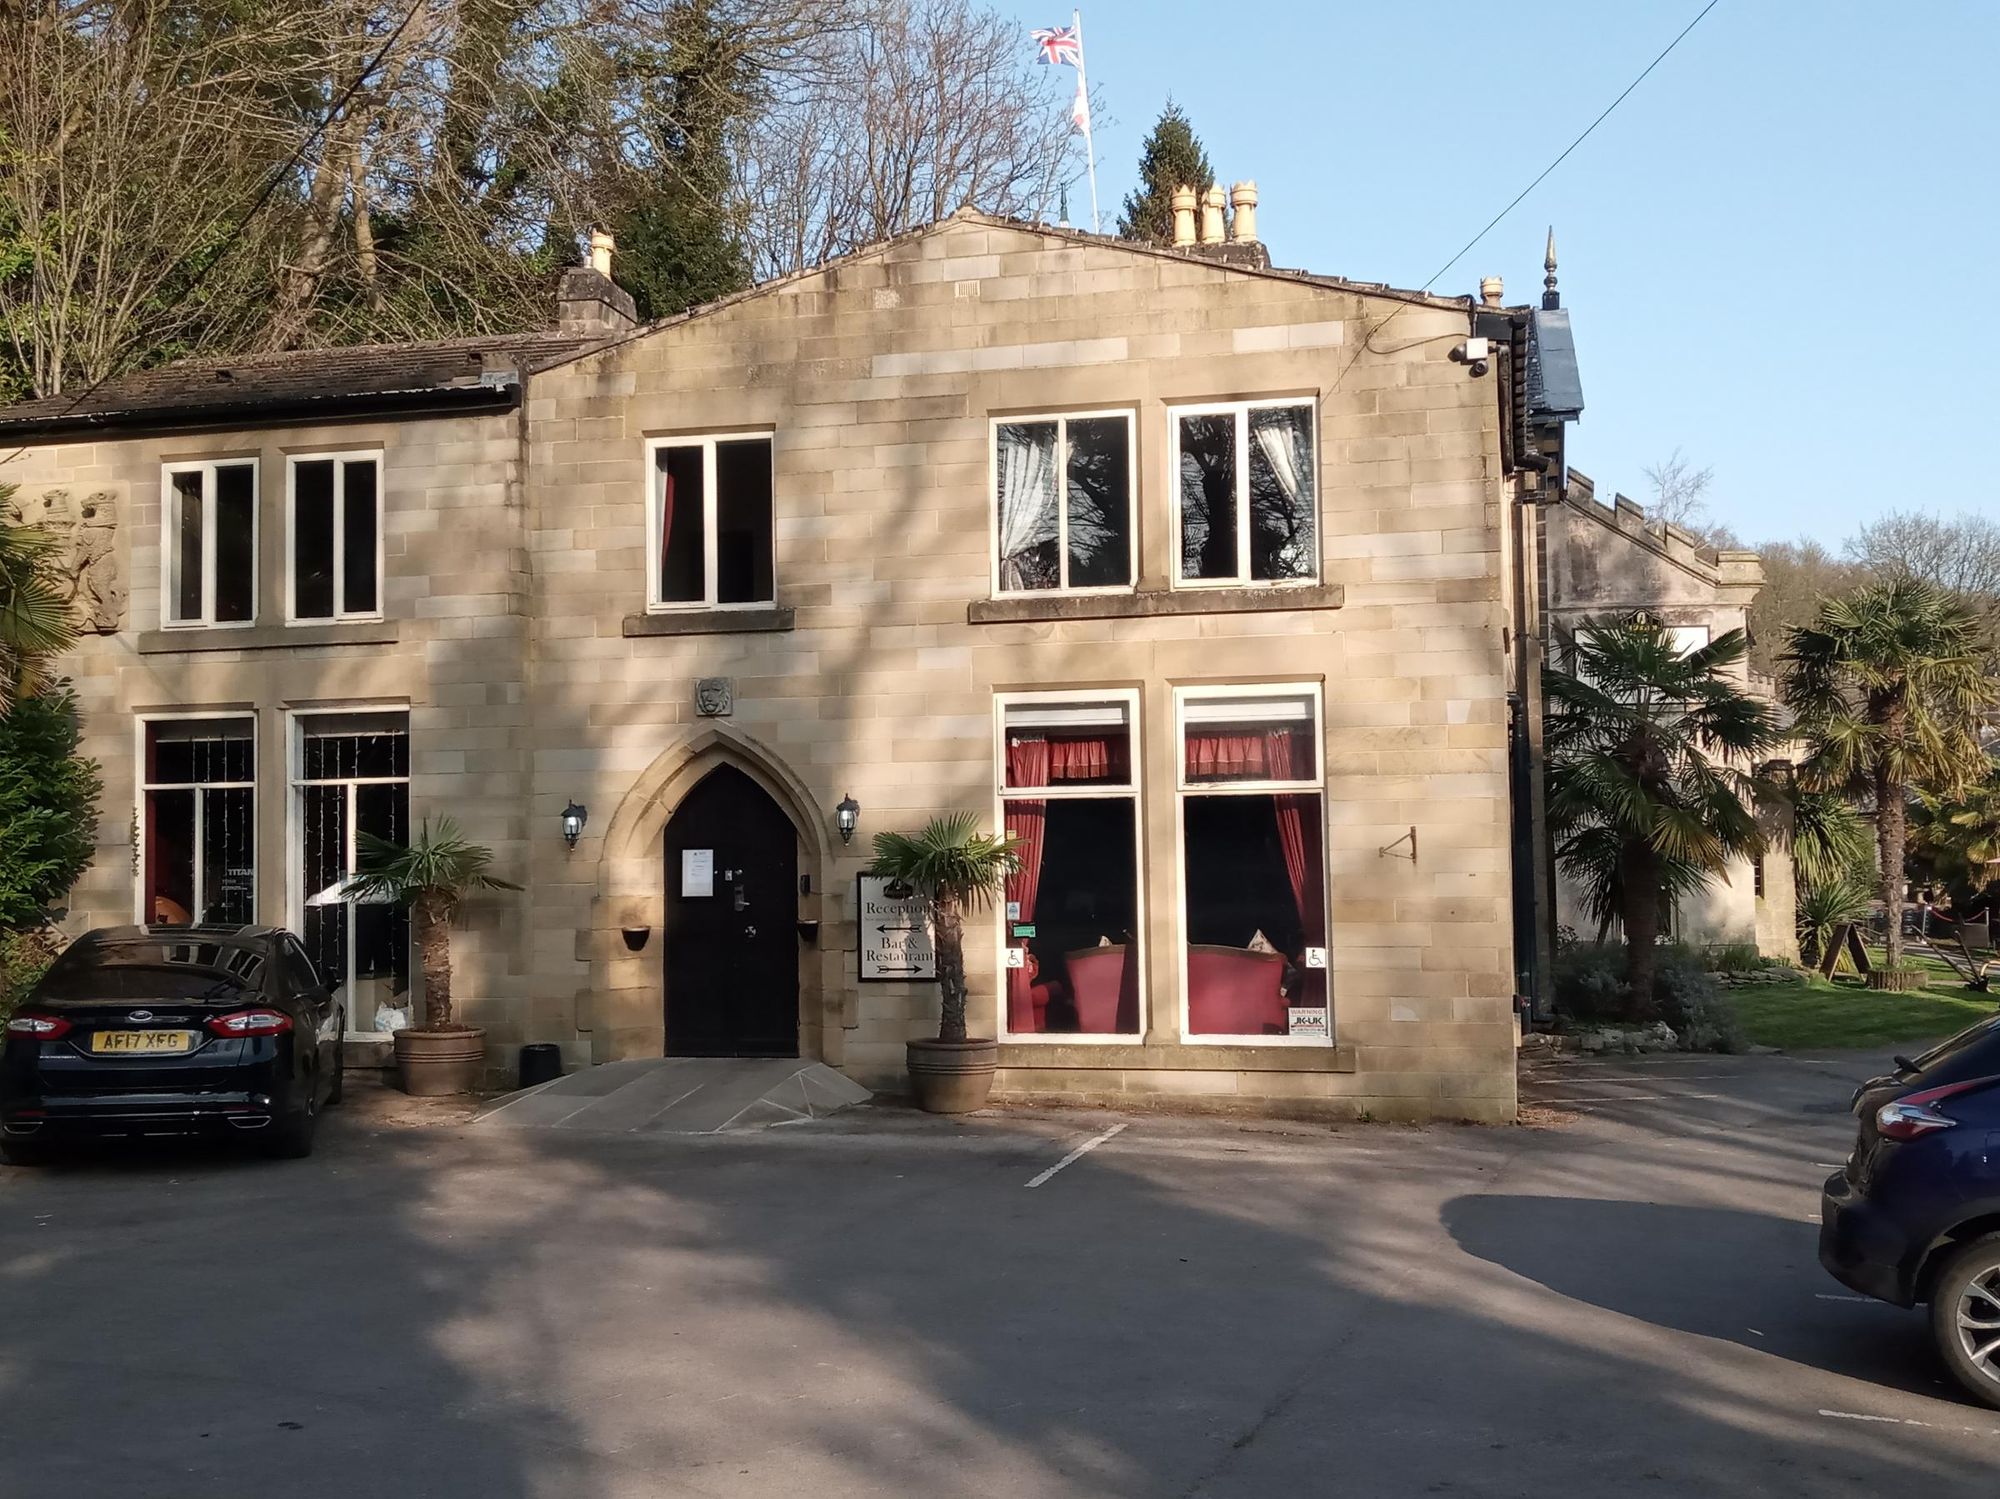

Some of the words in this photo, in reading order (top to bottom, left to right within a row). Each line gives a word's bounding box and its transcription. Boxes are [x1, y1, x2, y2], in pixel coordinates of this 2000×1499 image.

[866, 902, 930, 916] Reception
[881, 937, 903, 949] Bar
[908, 937, 919, 949] &
[866, 949, 933, 962] Restaurant
[104, 1033, 141, 1049] AF17
[145, 1033, 178, 1048] XFG
